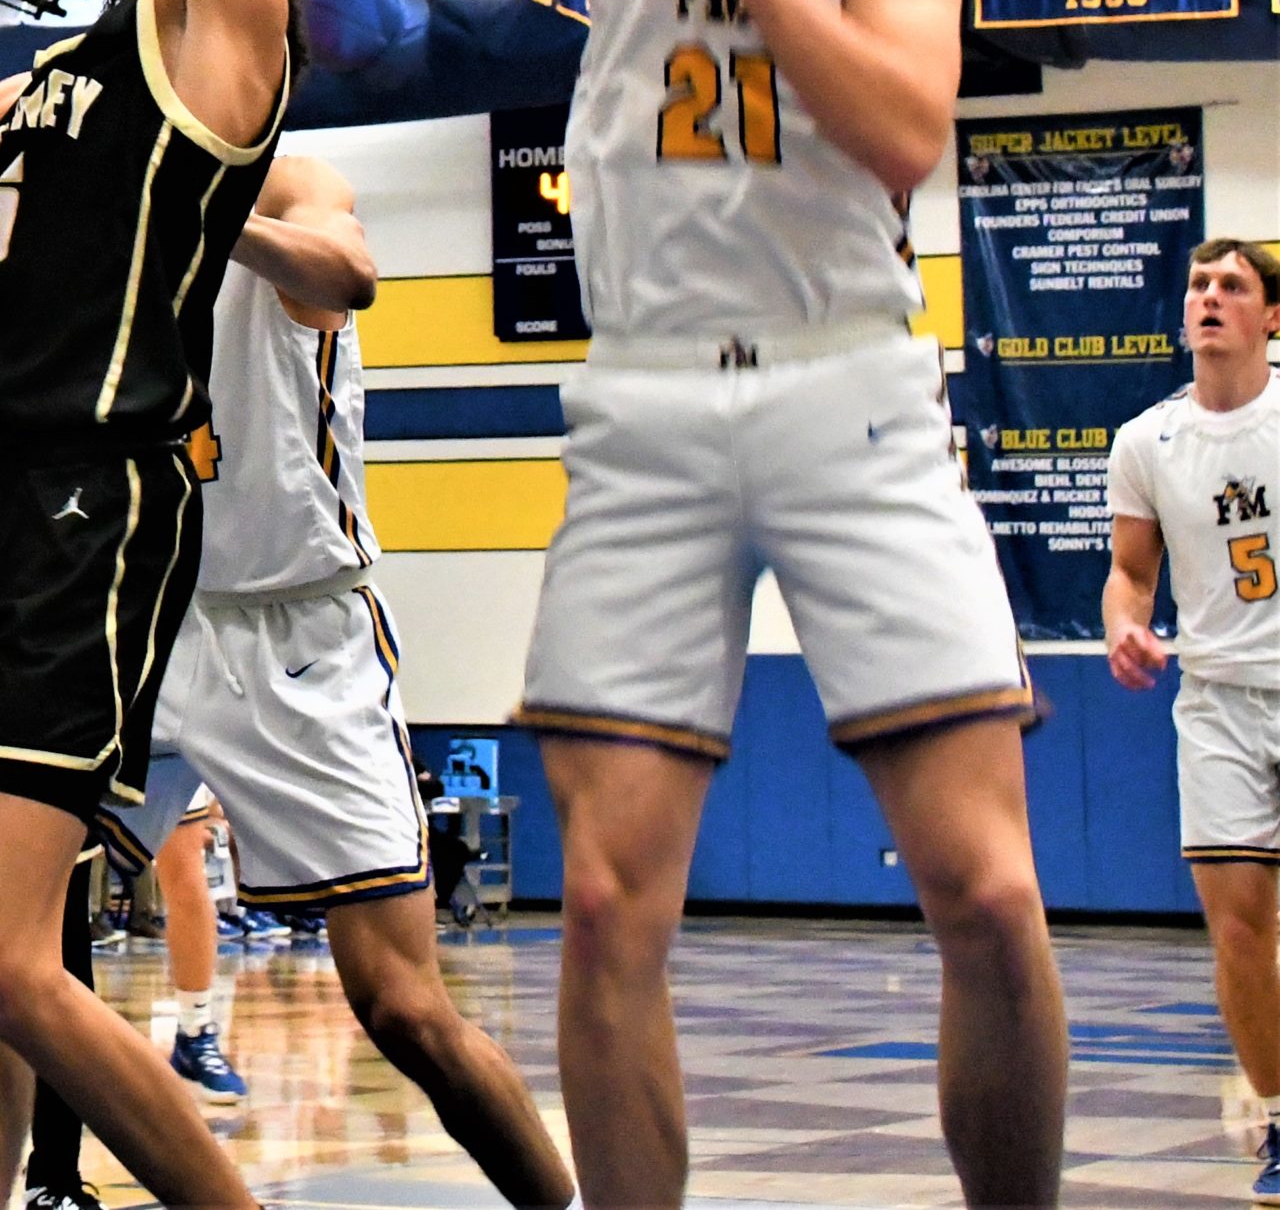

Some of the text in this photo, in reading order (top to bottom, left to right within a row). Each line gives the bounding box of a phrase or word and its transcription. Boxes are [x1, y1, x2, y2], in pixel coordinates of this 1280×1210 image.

[656, 43, 782, 166] 21
[969, 124, 1188, 154] SUPER JACKET LEVEL
[1015, 193, 1147, 212] EPPS ORTHODONTICS
[975, 207, 1190, 229] FOUNDERS FEDERAL CREDIT UNION
[1012, 242, 1161, 259] CRAMER PEST CONTROL
[516, 263, 557, 276] FOULS
[1031, 258, 1144, 275] SIGN TECHNIQUES
[1029, 275, 1144, 291] SUNBELT RENTALS
[516, 320, 558, 334] SCORE
[997, 334, 1174, 358] GOLD CLUB LEVEL
[1000, 427, 1108, 450] BLUE CLUB
[991, 458, 1054, 472] AWESOME
[1048, 537, 1104, 551] SONNY'S
[1227, 533, 1278, 602] 5
